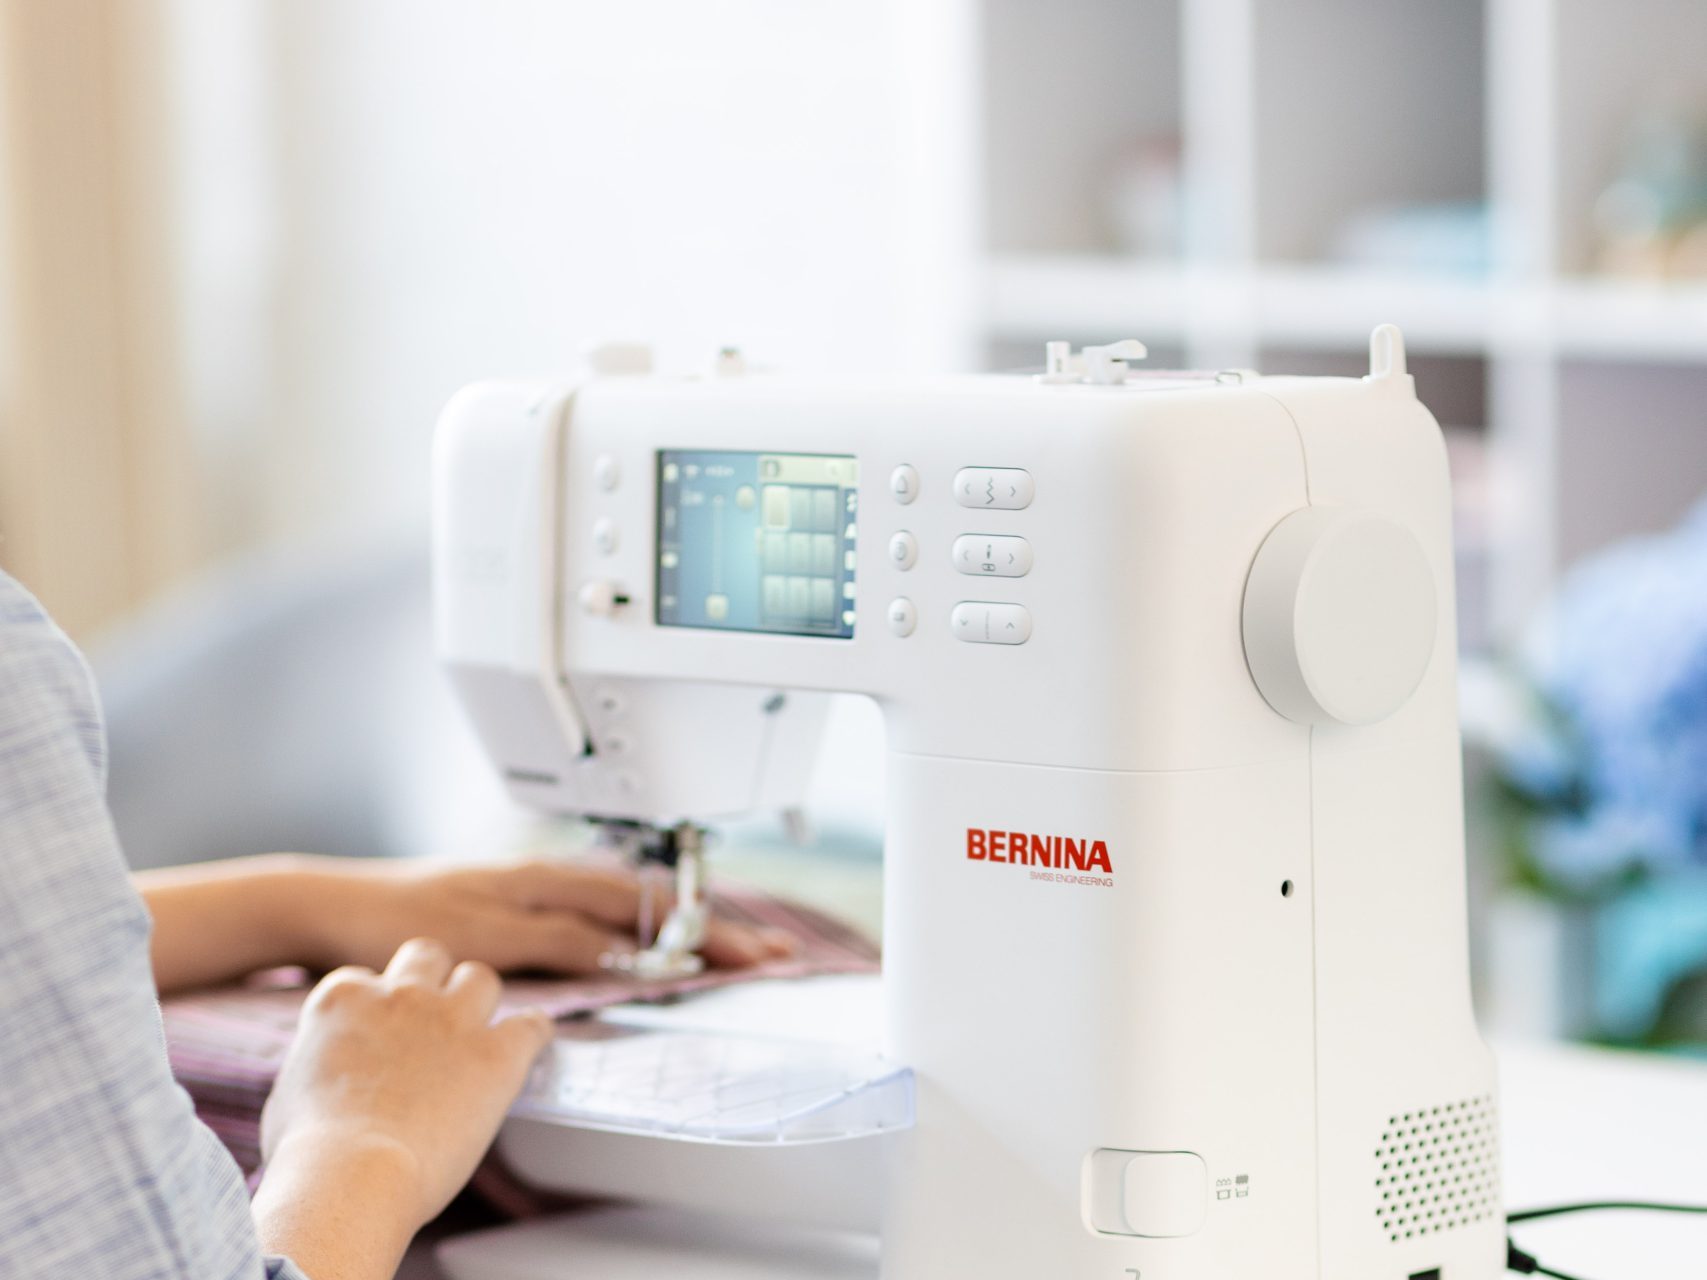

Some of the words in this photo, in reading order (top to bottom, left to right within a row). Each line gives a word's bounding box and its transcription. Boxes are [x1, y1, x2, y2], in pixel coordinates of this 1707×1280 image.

[966, 828, 1113, 873] BERNINA
[1029, 871, 1054, 882] SWISS
[1055, 873, 1113, 887] ENGINEERING
